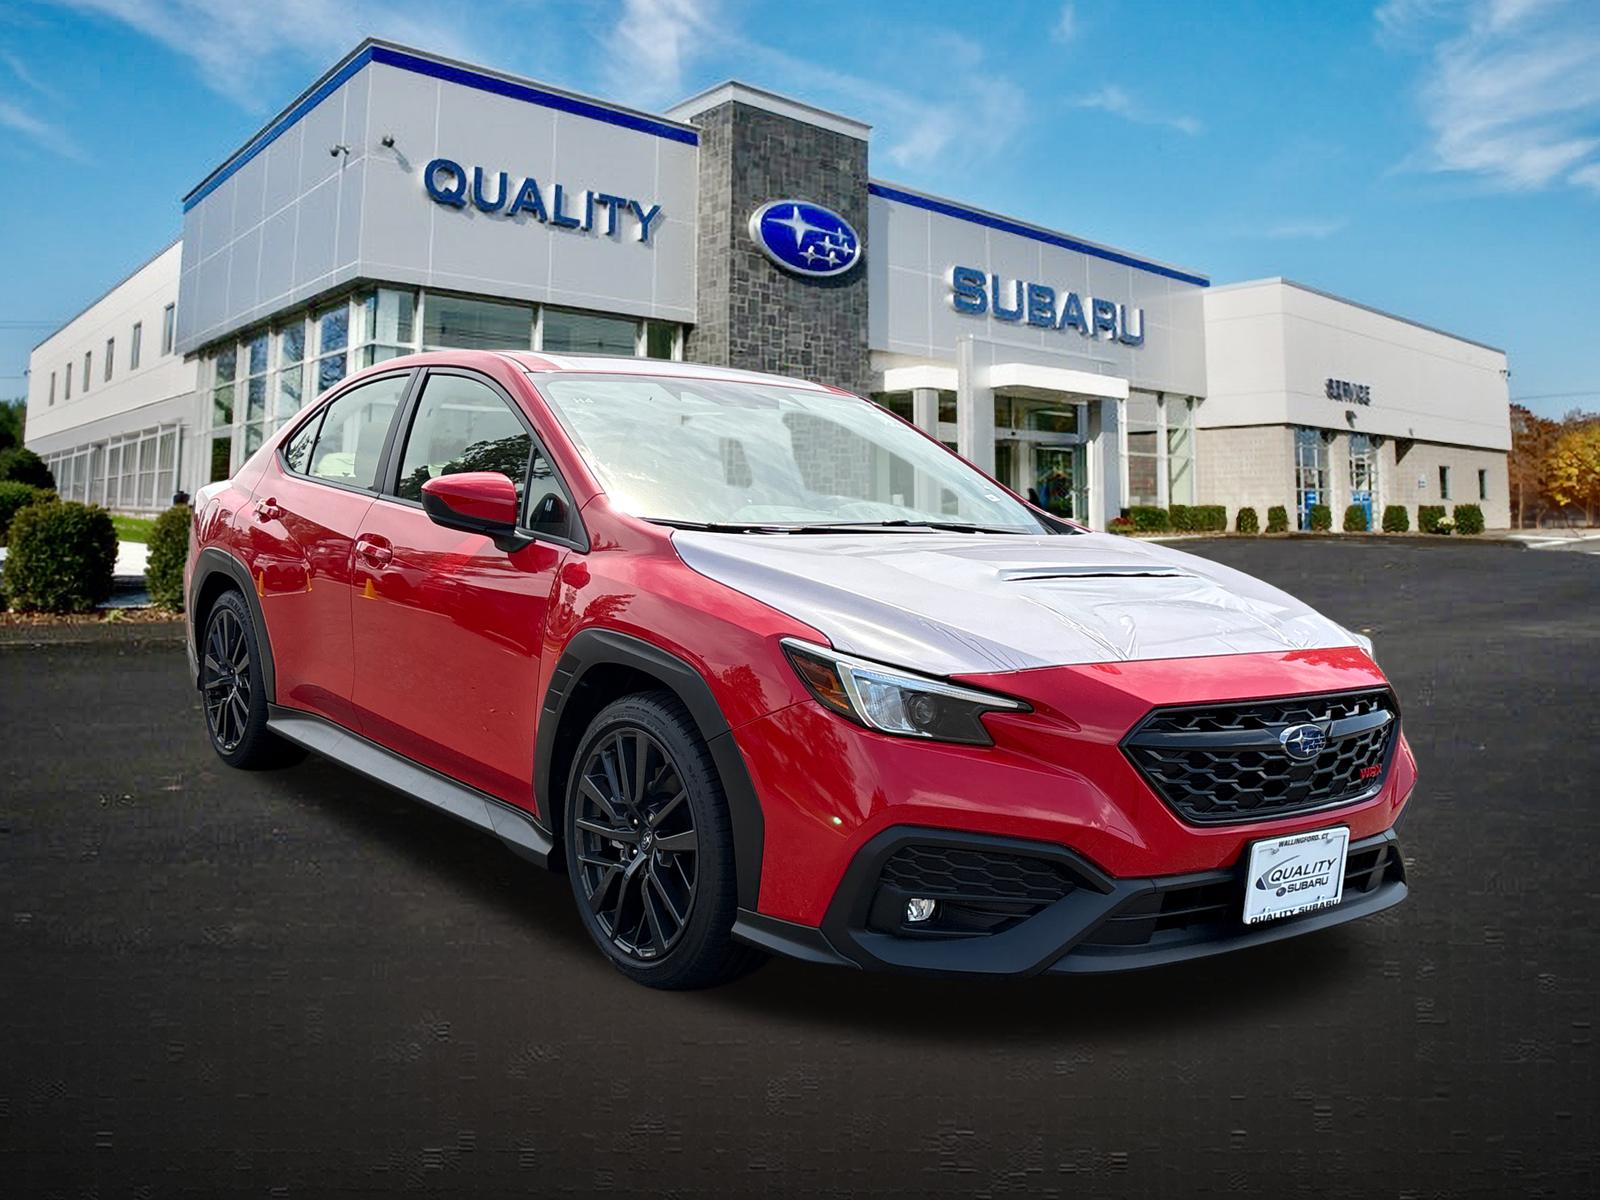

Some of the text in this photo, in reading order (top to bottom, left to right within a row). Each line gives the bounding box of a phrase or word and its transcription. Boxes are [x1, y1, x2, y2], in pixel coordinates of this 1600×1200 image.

[424, 158, 662, 242] QUALITY
[951, 265, 1145, 347] SUBARU
[1360, 764, 1382, 778] WRX
[1271, 858, 1337, 882] QUALITY
[1287, 876, 1329, 893] SUBARU
